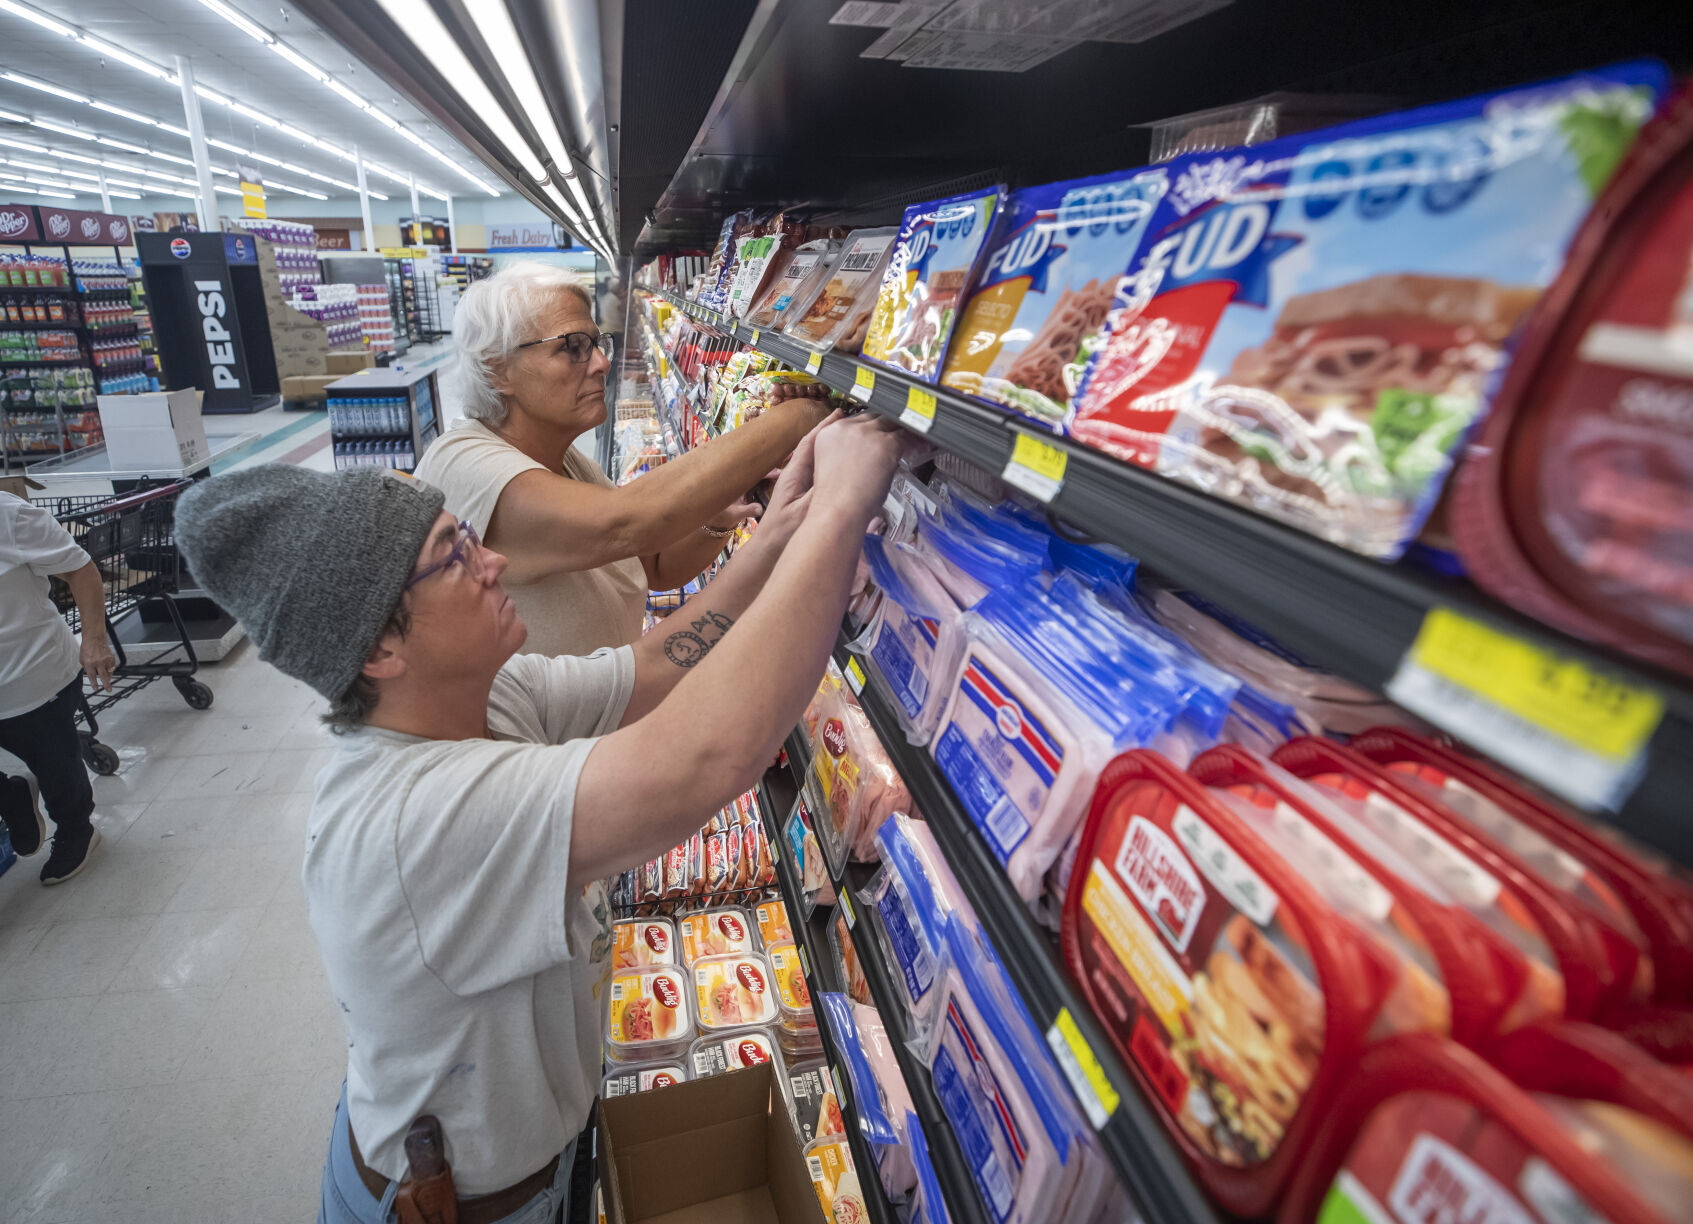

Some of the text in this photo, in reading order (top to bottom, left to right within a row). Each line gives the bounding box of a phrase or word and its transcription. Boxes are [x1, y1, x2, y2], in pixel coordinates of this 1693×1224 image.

[0, 216, 25, 233] epper
[1, 211, 15, 222] Dr
[491, 229, 551, 246] Fresh Dairy
[1143, 203, 1270, 281] FUD
[980, 227, 1052, 287] FUD
[194, 280, 240, 389] PEPSI
[824, 723, 846, 753] Buddig
[1121, 847, 1156, 899] FARM
[1131, 825, 1199, 913] HILLSHIRE
[648, 927, 667, 951] Buddig
[721, 916, 743, 940] Buddig
[656, 978, 679, 1006] Buddig
[739, 965, 764, 992] Buddig
